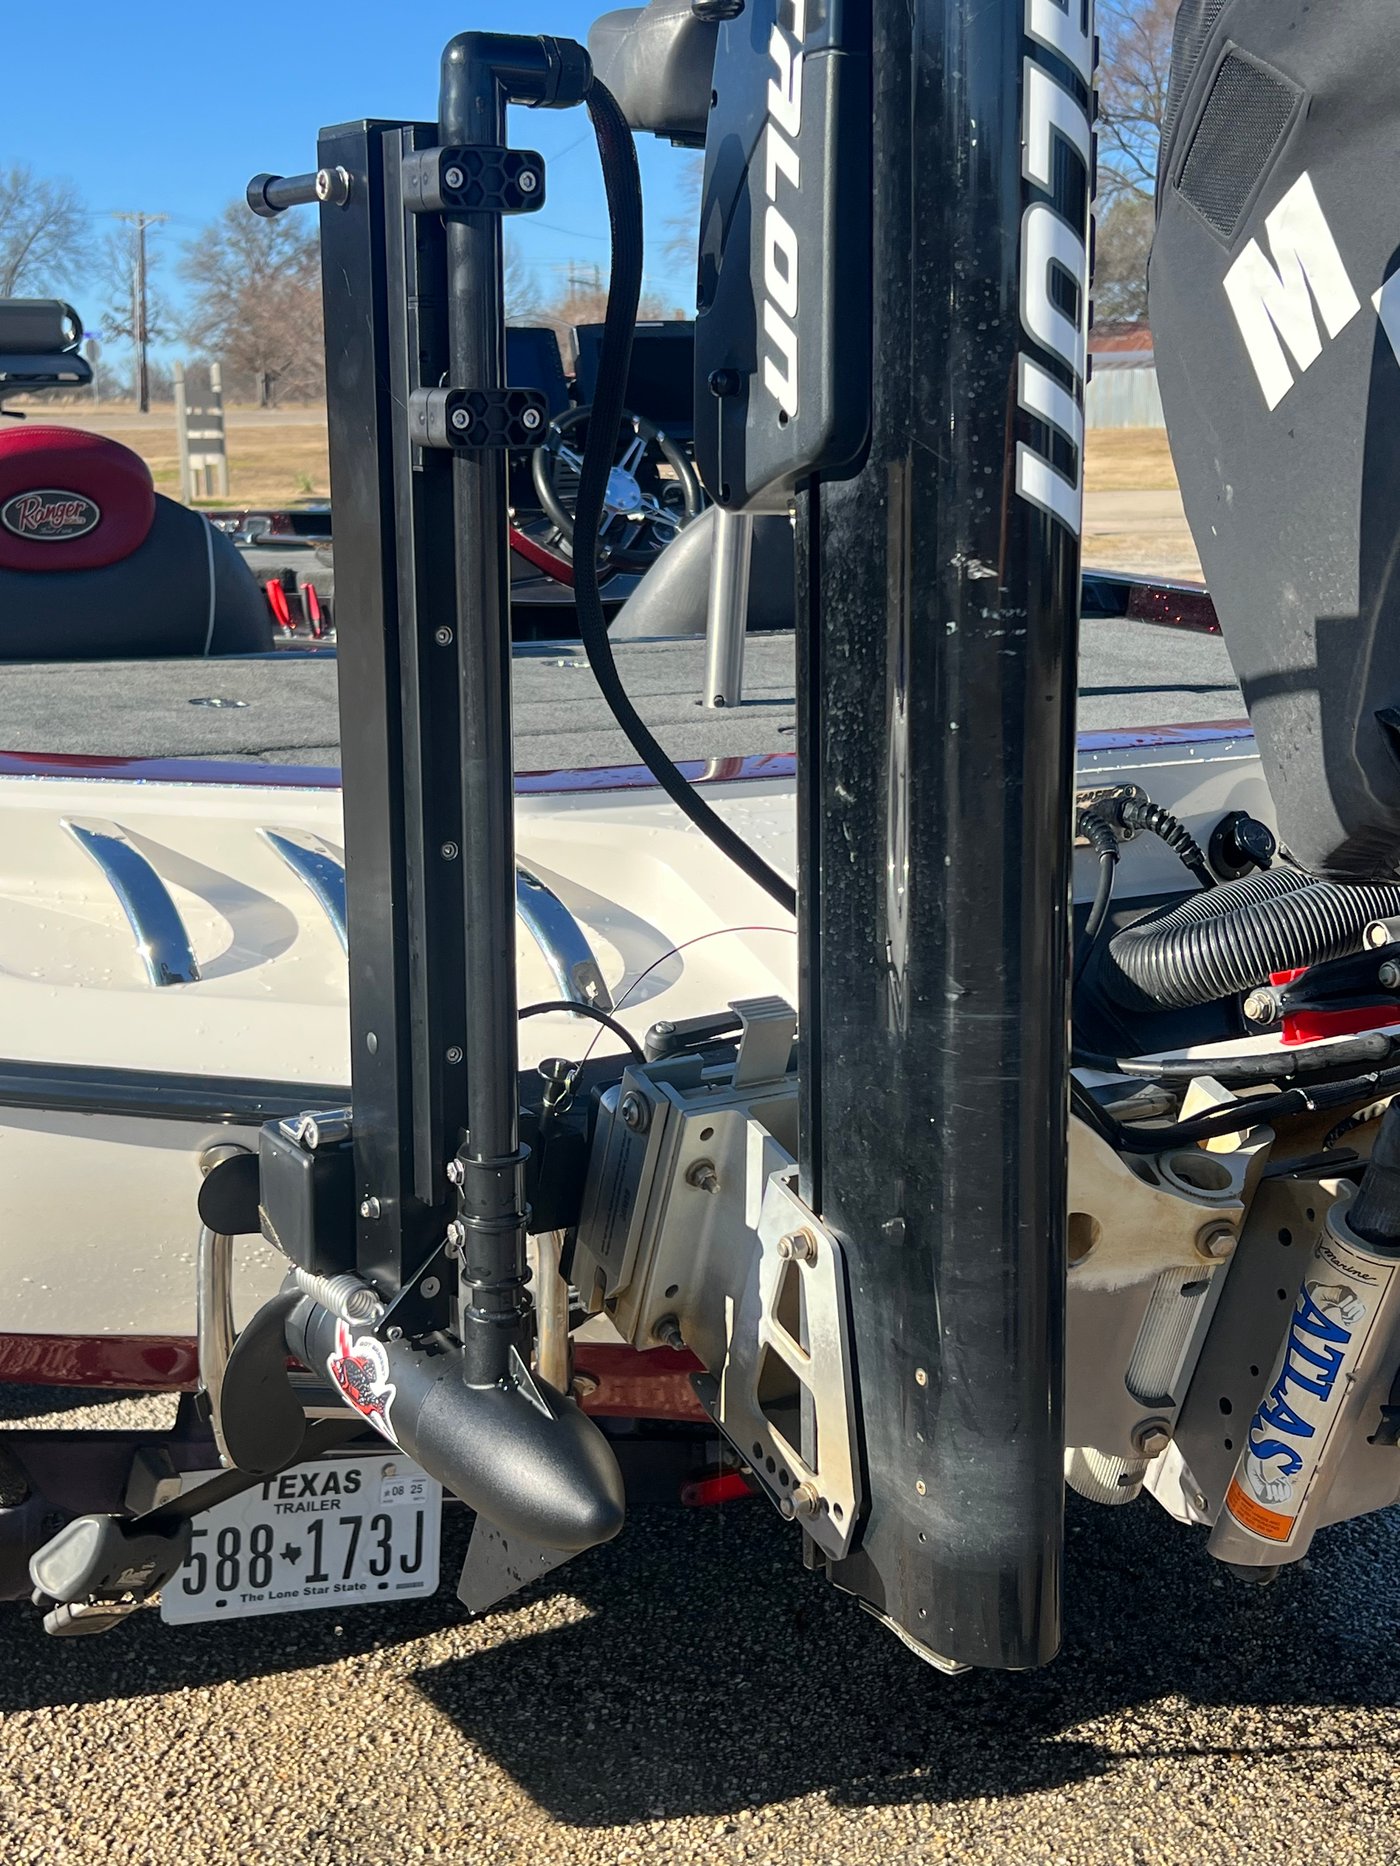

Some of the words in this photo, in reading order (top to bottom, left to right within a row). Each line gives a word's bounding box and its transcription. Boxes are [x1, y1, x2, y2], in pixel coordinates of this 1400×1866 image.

[16, 494, 87, 532] Ranger
[1248, 1280, 1352, 1477] ATLAS
[262, 1469, 362, 1501] TEXAS
[392, 1485, 405, 1496] 08
[410, 1484, 423, 1494] 25
[273, 1499, 341, 1515] TRAILER
[182, 1523, 274, 1596] 588
[305, 1510, 425, 1584] 173J
[240, 1593, 265, 1603] The
[268, 1590, 299, 1600] Lone
[303, 1585, 330, 1596] Star
[333, 1581, 367, 1592] State
